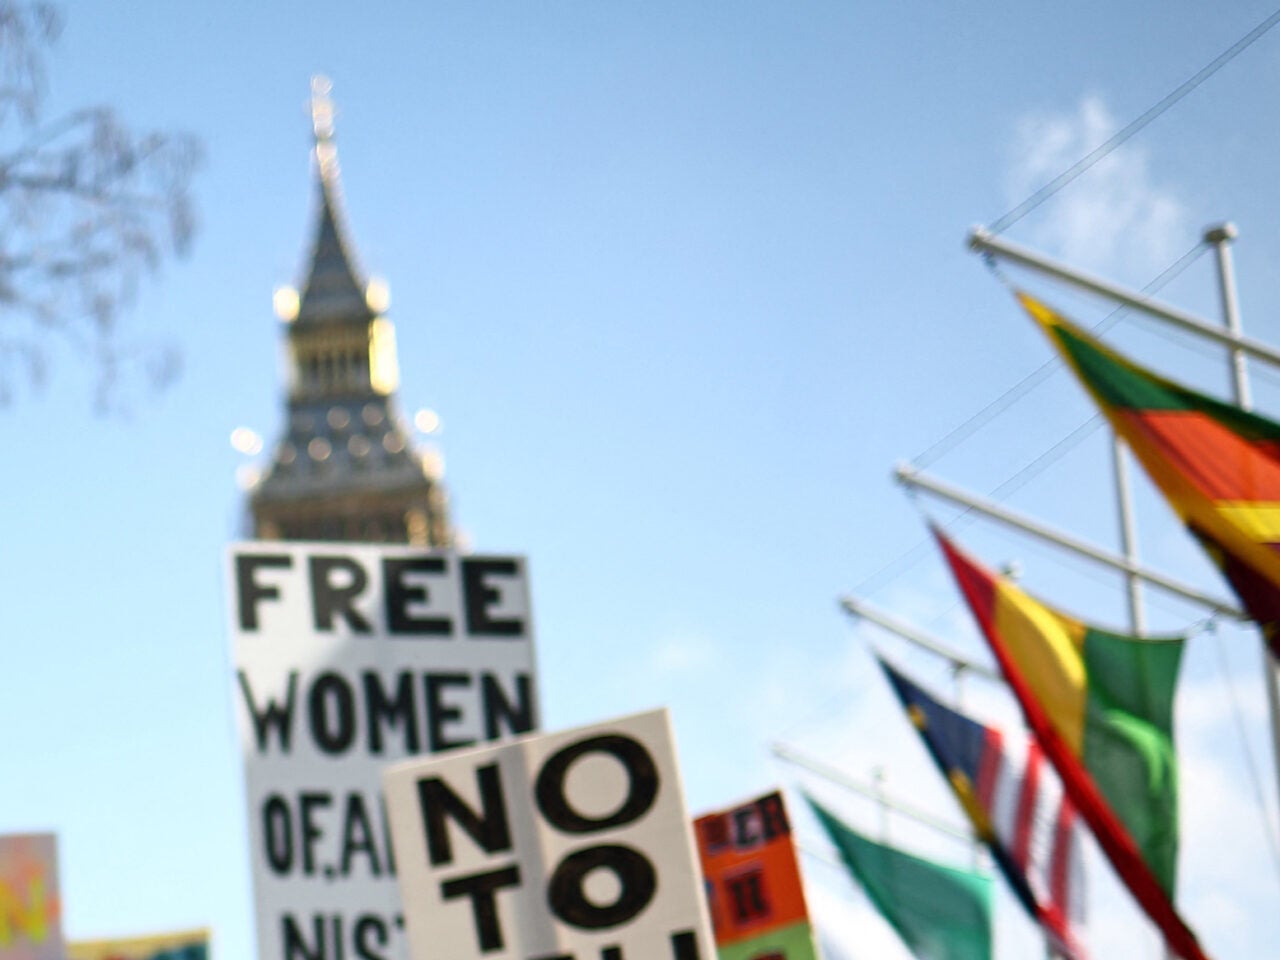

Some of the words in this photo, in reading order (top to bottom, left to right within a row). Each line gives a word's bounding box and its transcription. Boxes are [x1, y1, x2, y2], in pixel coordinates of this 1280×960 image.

[233, 553, 526, 637] FREE
[237, 668, 537, 759] WOMEN
[415, 731, 660, 867] NO
[440, 843, 658, 954] TO
